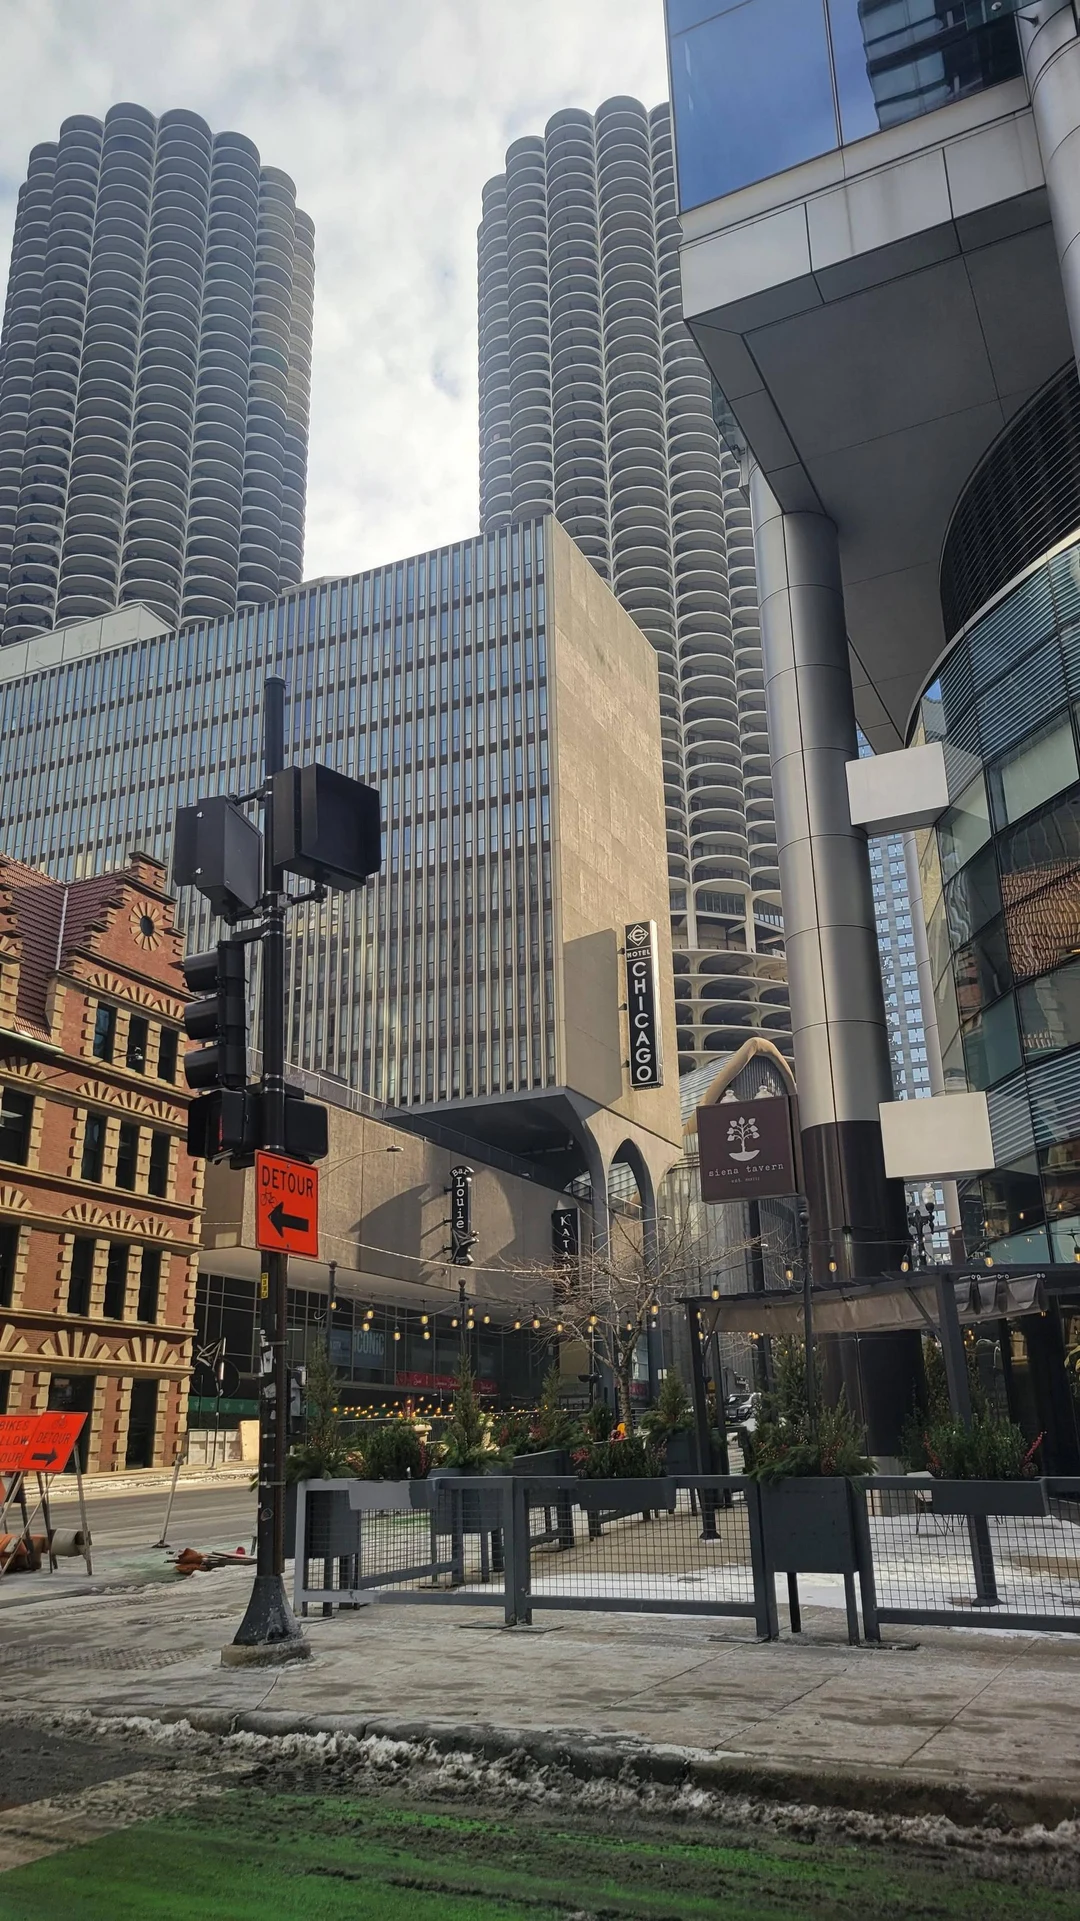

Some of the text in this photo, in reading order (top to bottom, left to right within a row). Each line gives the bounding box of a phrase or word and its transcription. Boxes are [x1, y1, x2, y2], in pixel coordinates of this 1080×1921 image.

[627, 949, 651, 958] HOTEL
[632, 961, 652, 1082] CHICAGO
[451, 1167, 469, 1177] Bar
[708, 1163, 784, 1177] siena tavern
[262, 1165, 314, 1198] DETOUR
[456, 1177, 465, 1228] Louie
[36, 1431, 71, 1445] DETOUR
